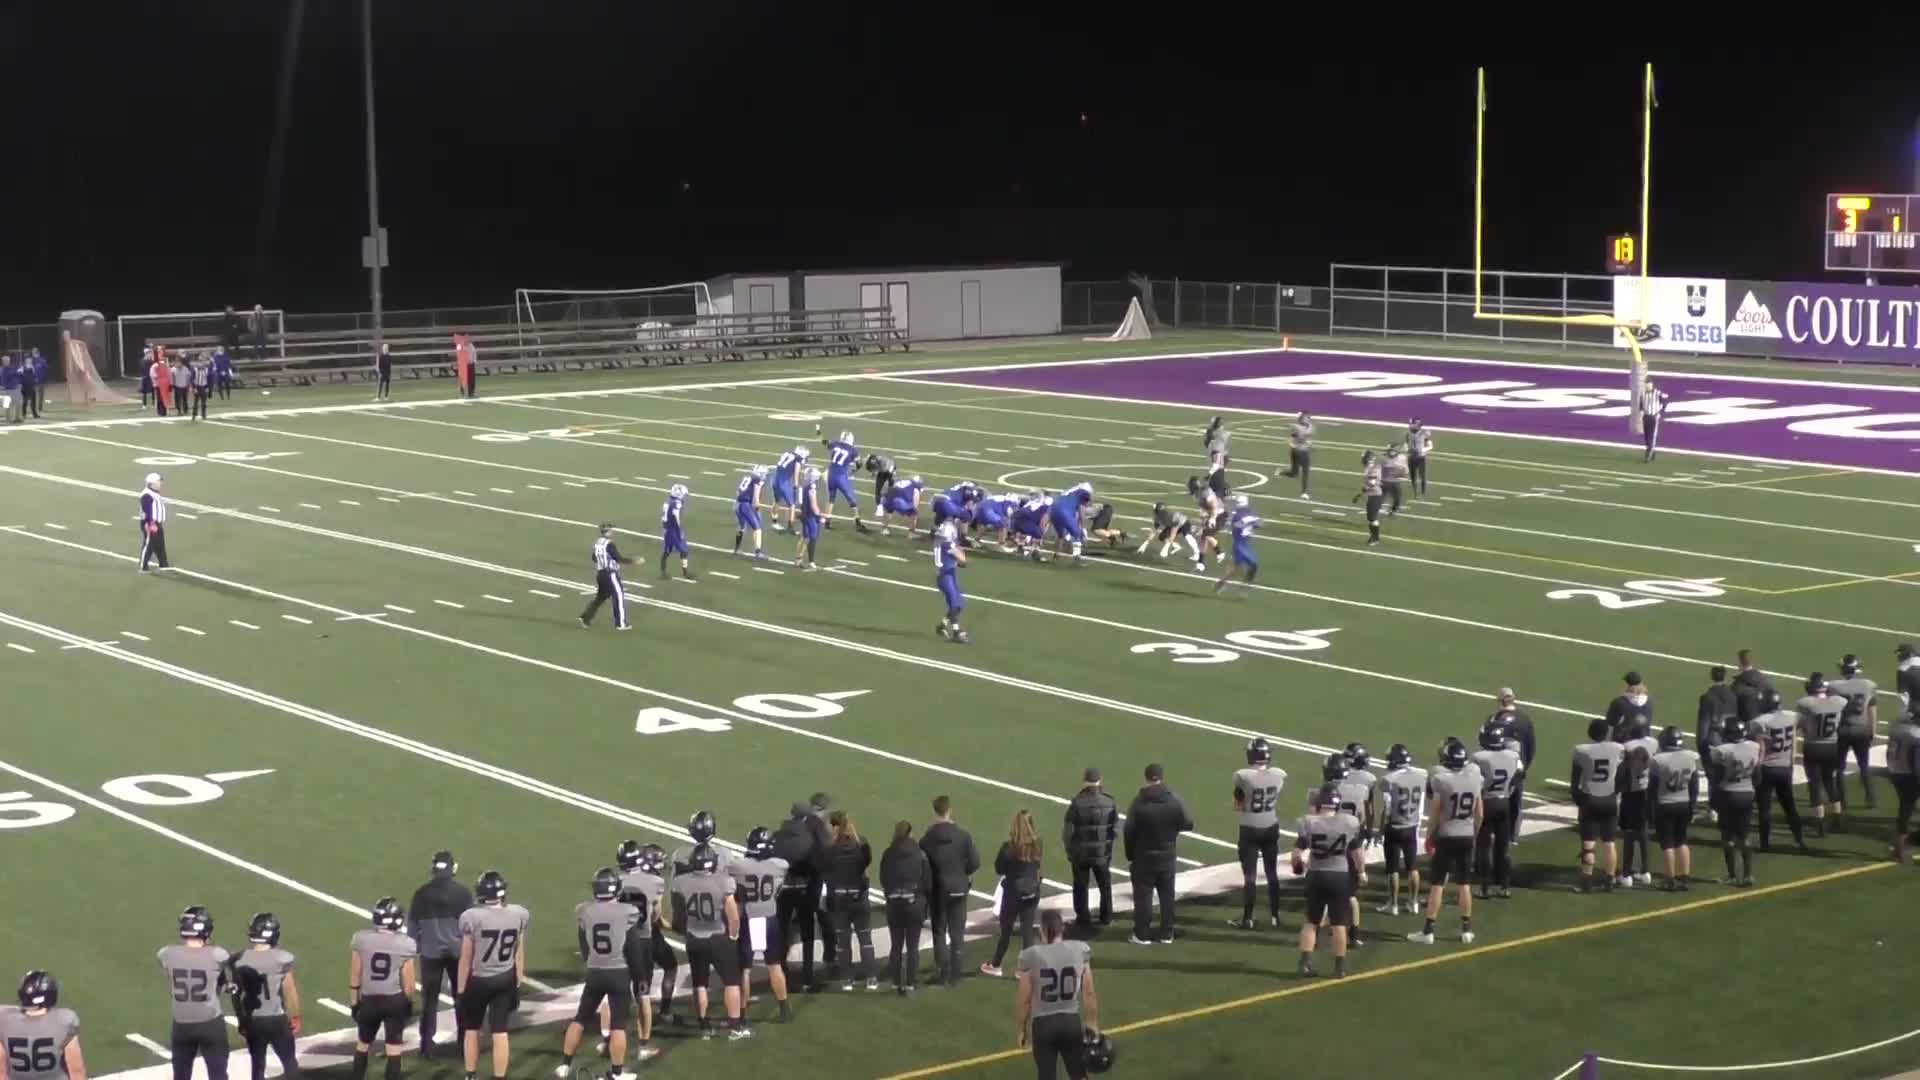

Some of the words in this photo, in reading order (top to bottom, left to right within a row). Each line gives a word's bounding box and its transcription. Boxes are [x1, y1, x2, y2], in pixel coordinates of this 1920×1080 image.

[1670, 323, 1724, 344] RSEQ
[832, 447, 849, 466] 77
[1546, 577, 1727, 609] 20
[1130, 630, 1331, 663] 30
[635, 692, 845, 735] 40
[1488, 769, 1508, 792] 2
[1592, 759, 1609, 782] 5
[1450, 791, 1475, 819] 19
[1311, 832, 1347, 860] 54
[687, 892, 715, 921] 40
[481, 928, 518, 963] 78
[592, 923, 612, 955] 6
[370, 952, 392, 981] 9
[172, 967, 207, 1002] 52
[1040, 966, 1077, 1001] 20
[7, 1037, 56, 1072] 56
